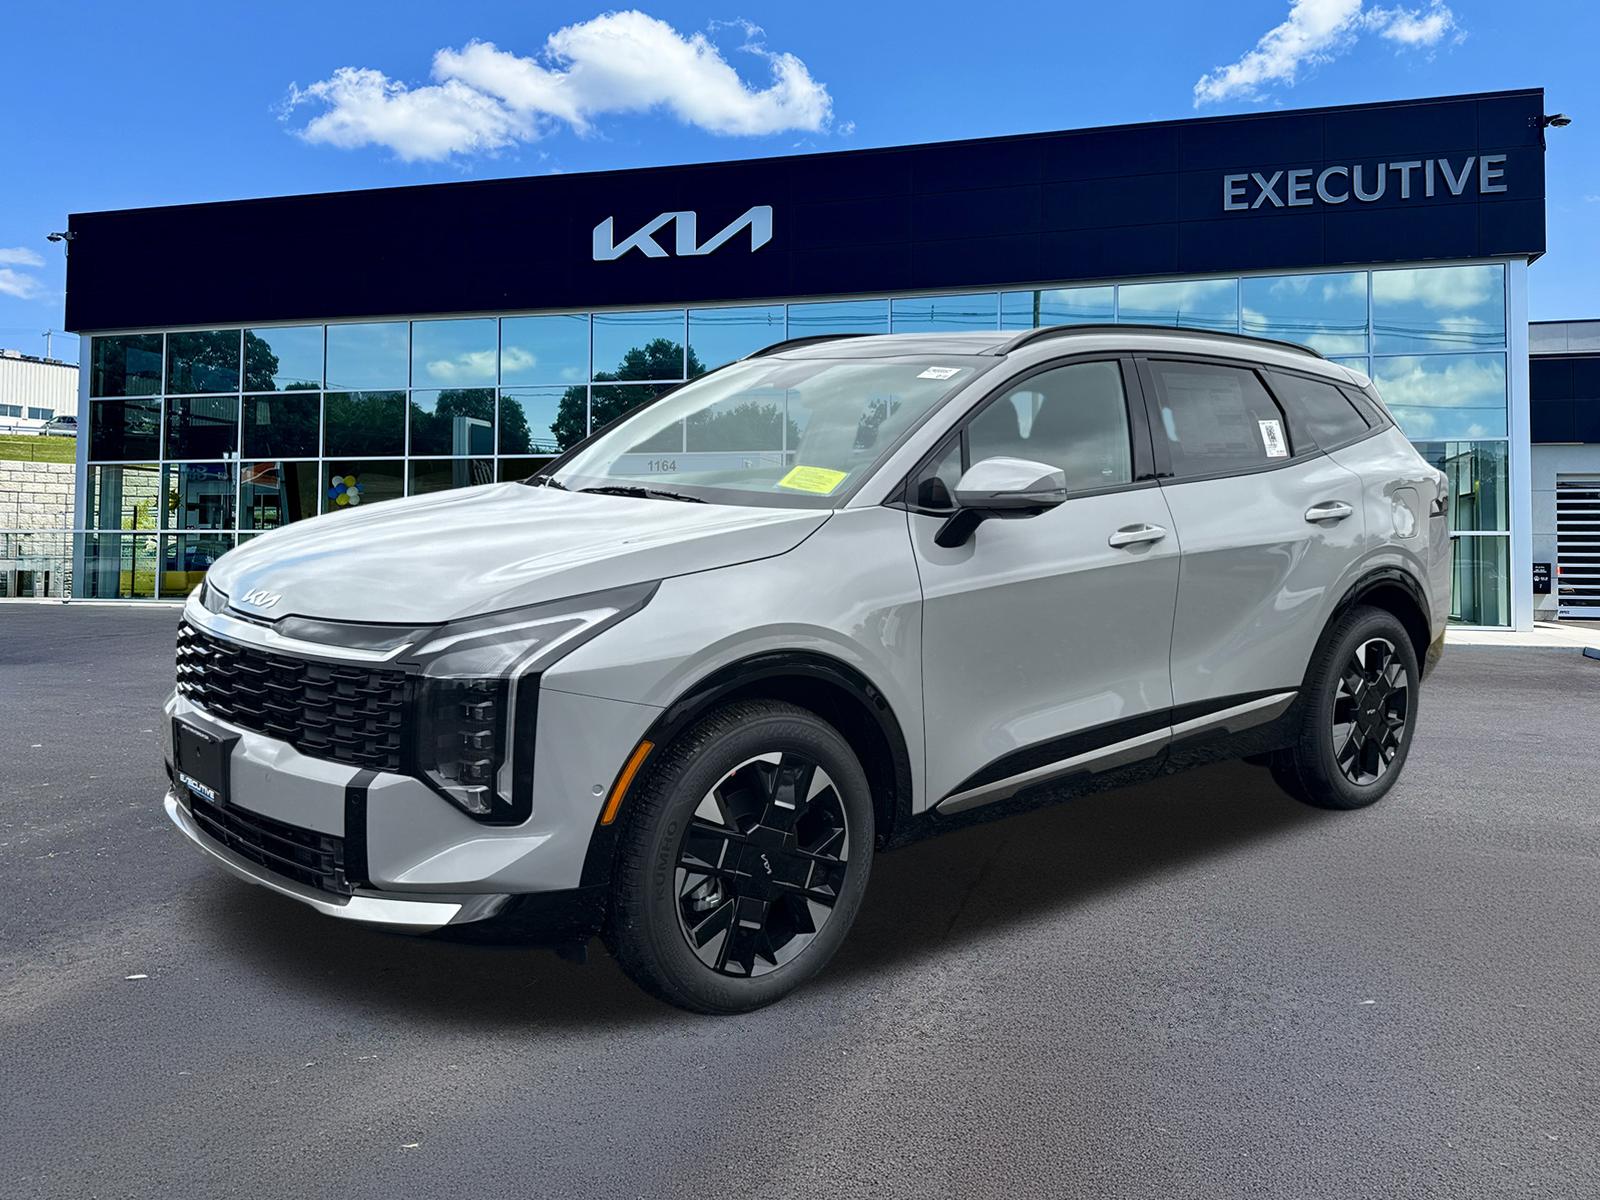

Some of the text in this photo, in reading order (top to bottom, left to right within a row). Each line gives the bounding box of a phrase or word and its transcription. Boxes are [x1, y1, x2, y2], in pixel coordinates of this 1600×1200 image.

[1223, 154, 1508, 212] EXECUTIVE
[593, 205, 773, 261] KIA
[647, 459, 677, 472] 1164
[241, 588, 282, 609] KIA
[655, 820, 678, 901] KUMHO
